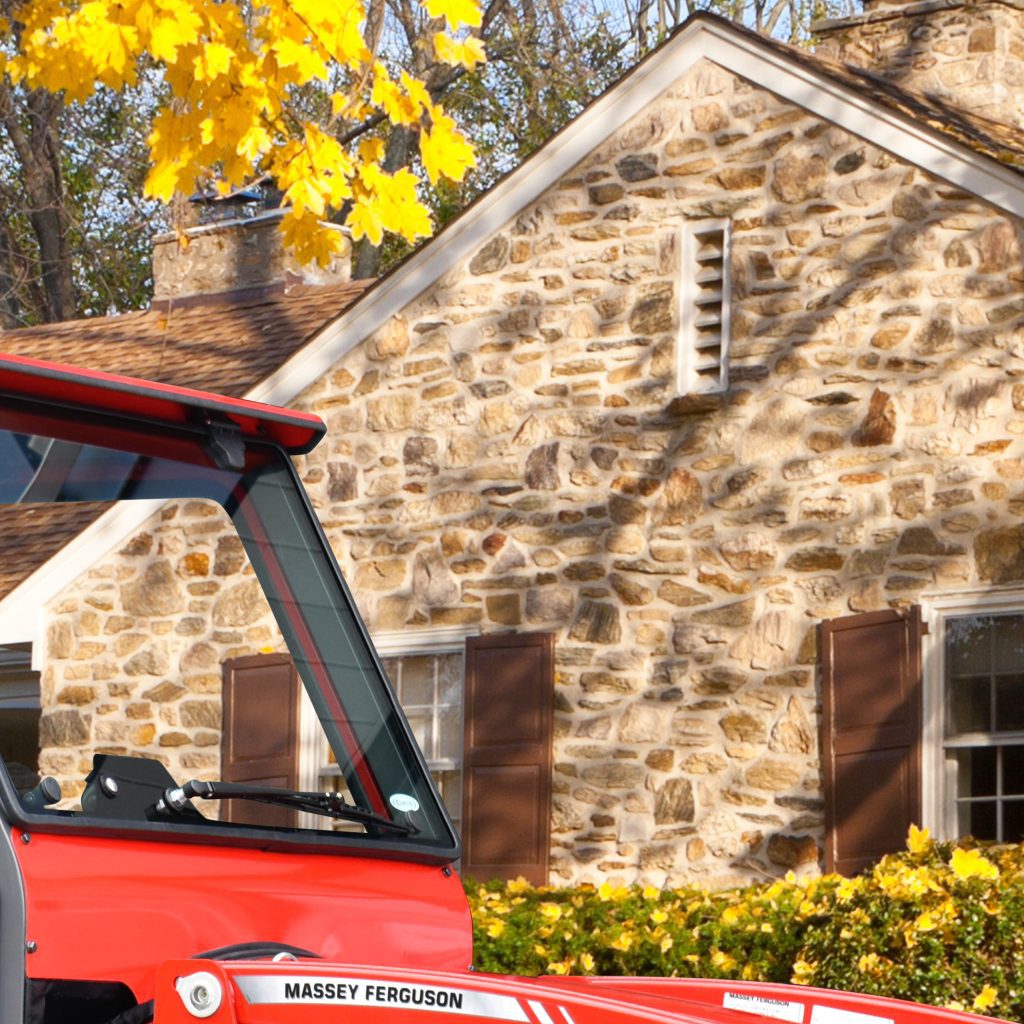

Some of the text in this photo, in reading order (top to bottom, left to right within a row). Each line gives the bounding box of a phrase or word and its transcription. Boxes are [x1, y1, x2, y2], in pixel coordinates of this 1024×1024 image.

[285, 983, 463, 1009] MASSEY FERGUSON
[729, 992, 754, 1002] MASSEY
